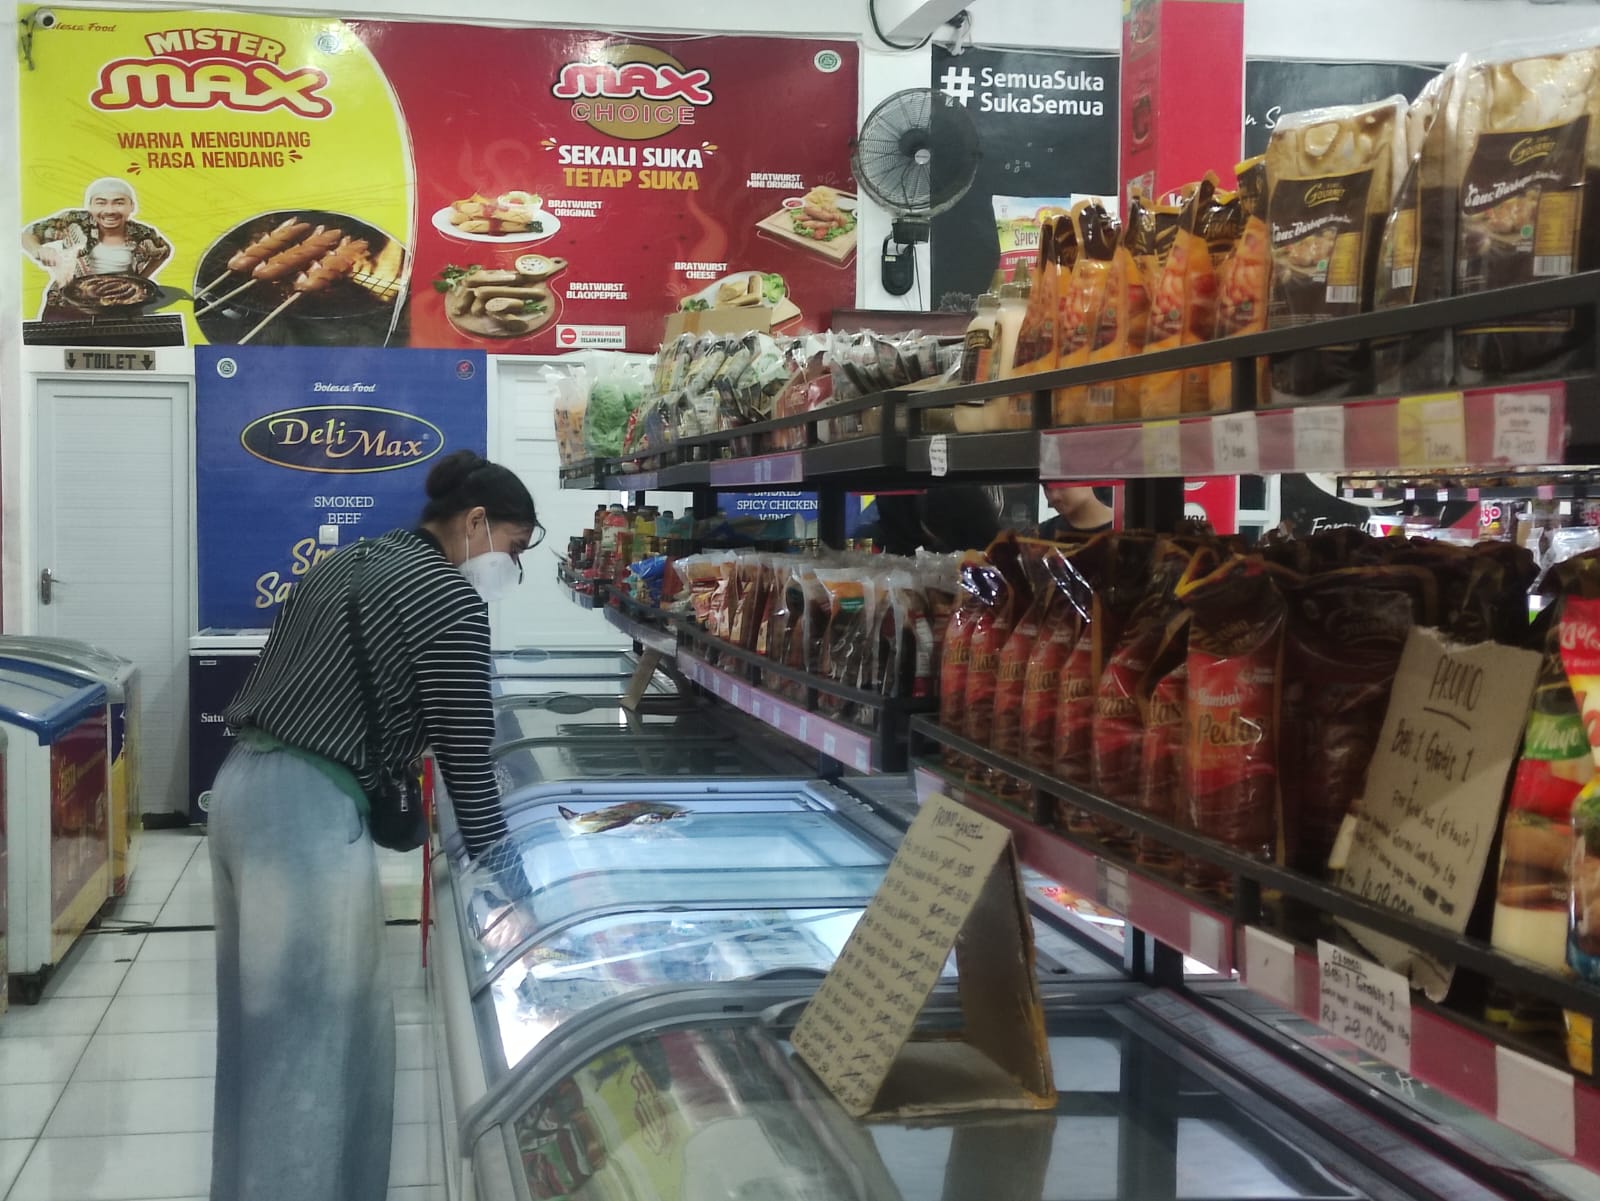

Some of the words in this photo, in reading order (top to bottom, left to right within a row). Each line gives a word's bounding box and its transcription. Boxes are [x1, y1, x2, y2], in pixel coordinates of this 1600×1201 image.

[88, 22, 117, 32] Food
[147, 28, 284, 62] MISTER
[554, 63, 711, 104] MAX
[980, 67, 1104, 91] SemuaSuka
[96, 61, 328, 116] MAX
[980, 92, 1104, 116] SukaSemua
[571, 102, 695, 125] CHOICE
[117, 132, 184, 149] WARNA
[191, 131, 311, 149] MENGUNDANG
[148, 151, 195, 169] RASA
[202, 151, 284, 168] NENDANG
[558, 145, 636, 166] SEKALI
[642, 147, 703, 168] SUKA
[563, 167, 633, 188] TETAP
[638, 169, 699, 190] SUKA
[750, 173, 801, 181] BRATWURST
[746, 180, 766, 188] MINI
[766, 180, 804, 189] ORIGINAL
[548, 199, 602, 209] BRATWURST
[554, 208, 596, 217] ORIGINAL
[674, 262, 727, 271] BRATWURST
[686, 271, 716, 279] CHEESE
[569, 282, 624, 291] BRATWURST
[566, 290, 627, 300] BLACKPEPPER
[82, 352, 137, 370] TOILET
[313, 382, 350, 392] Bolesca
[351, 382, 376, 393] Food
[268, 418, 346, 446] Deli
[325, 430, 423, 458] Max
[313, 496, 374, 508] SMOKED
[737, 500, 767, 510] SPICY
[769, 500, 818, 510] CHICKEN
[327, 513, 361, 525] BEEF
